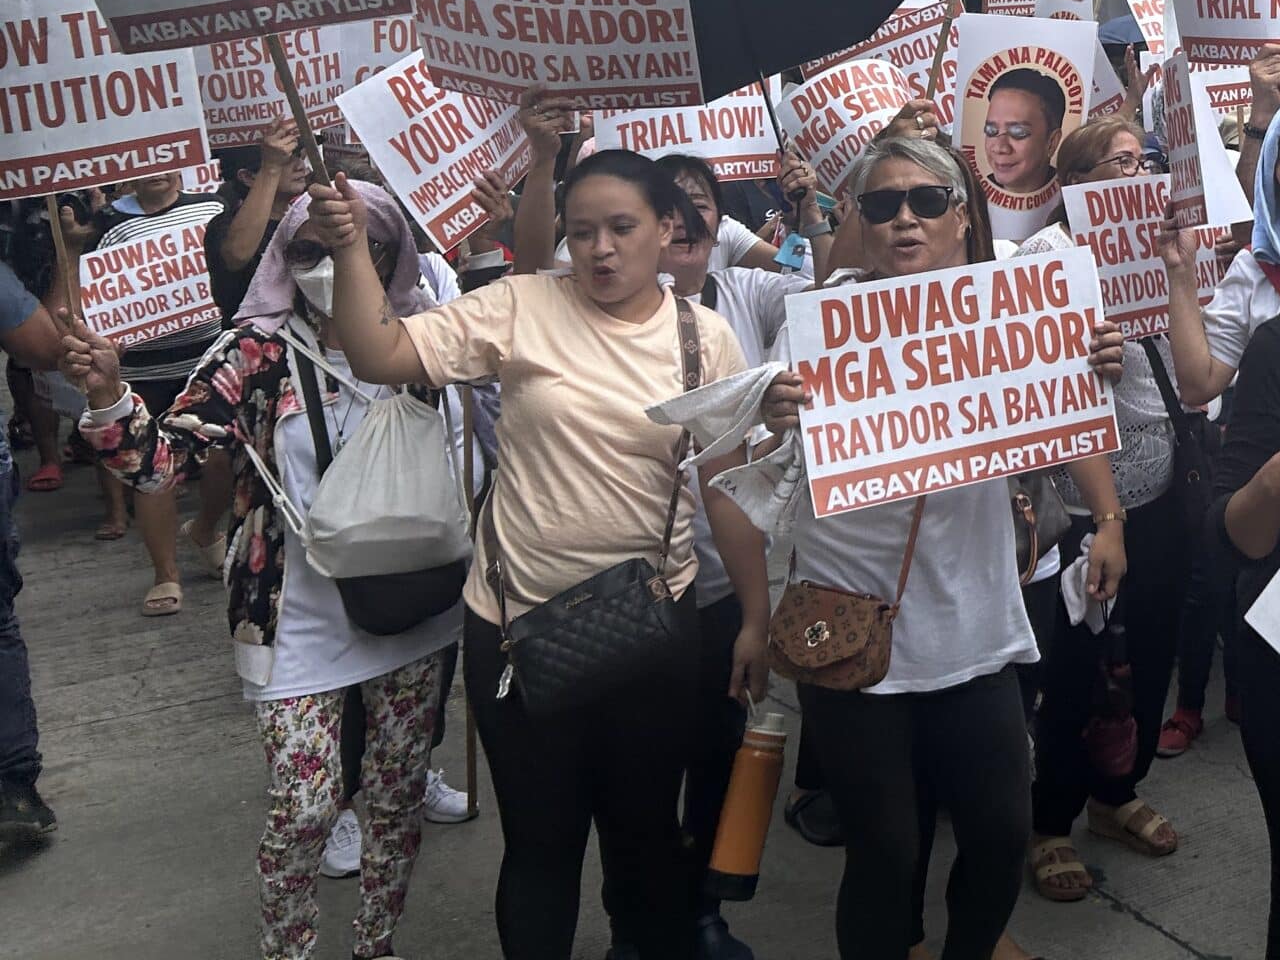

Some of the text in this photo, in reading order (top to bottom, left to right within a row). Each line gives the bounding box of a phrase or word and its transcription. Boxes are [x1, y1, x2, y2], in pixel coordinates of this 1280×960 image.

[61, 11, 121, 59] TH
[129, 7, 251, 46] AKBAYAN
[493, 5, 689, 45] SENADOR!
[421, 32, 693, 83] TRAYDOR SA BAYAN!
[967, 57, 1007, 99] TAMA
[1008, 46, 1032, 65] NA
[1034, 47, 1083, 115] PALUSOT!
[441, 76, 692, 108] AKBAY ARTYLIST
[791, 63, 888, 123] DUWAG
[389, 103, 474, 175] YOUR
[617, 106, 764, 152] TRIAL NOW!
[794, 107, 846, 161] MGA
[32, 140, 190, 186] PARTYLIST
[409, 140, 497, 215] IMPEACHMENT
[710, 159, 775, 176] ARTYLIST
[441, 201, 486, 241] AKBA
[1085, 181, 1170, 227] DUWAG
[87, 234, 178, 280] DUWAG
[1076, 225, 1135, 267] MGA
[80, 274, 136, 309] MGA
[89, 286, 195, 332] TRAYDOR SA
[820, 260, 1069, 350] DUWAG ANG
[1101, 269, 1169, 307] RAYDOR
[114, 319, 180, 347] KBAYAN
[798, 308, 1097, 412] MGA SENADOR!
[807, 370, 1108, 467] TRAYDOR SA BAYAN!
[826, 428, 1107, 511] AKBAYAN PARTYLIST
